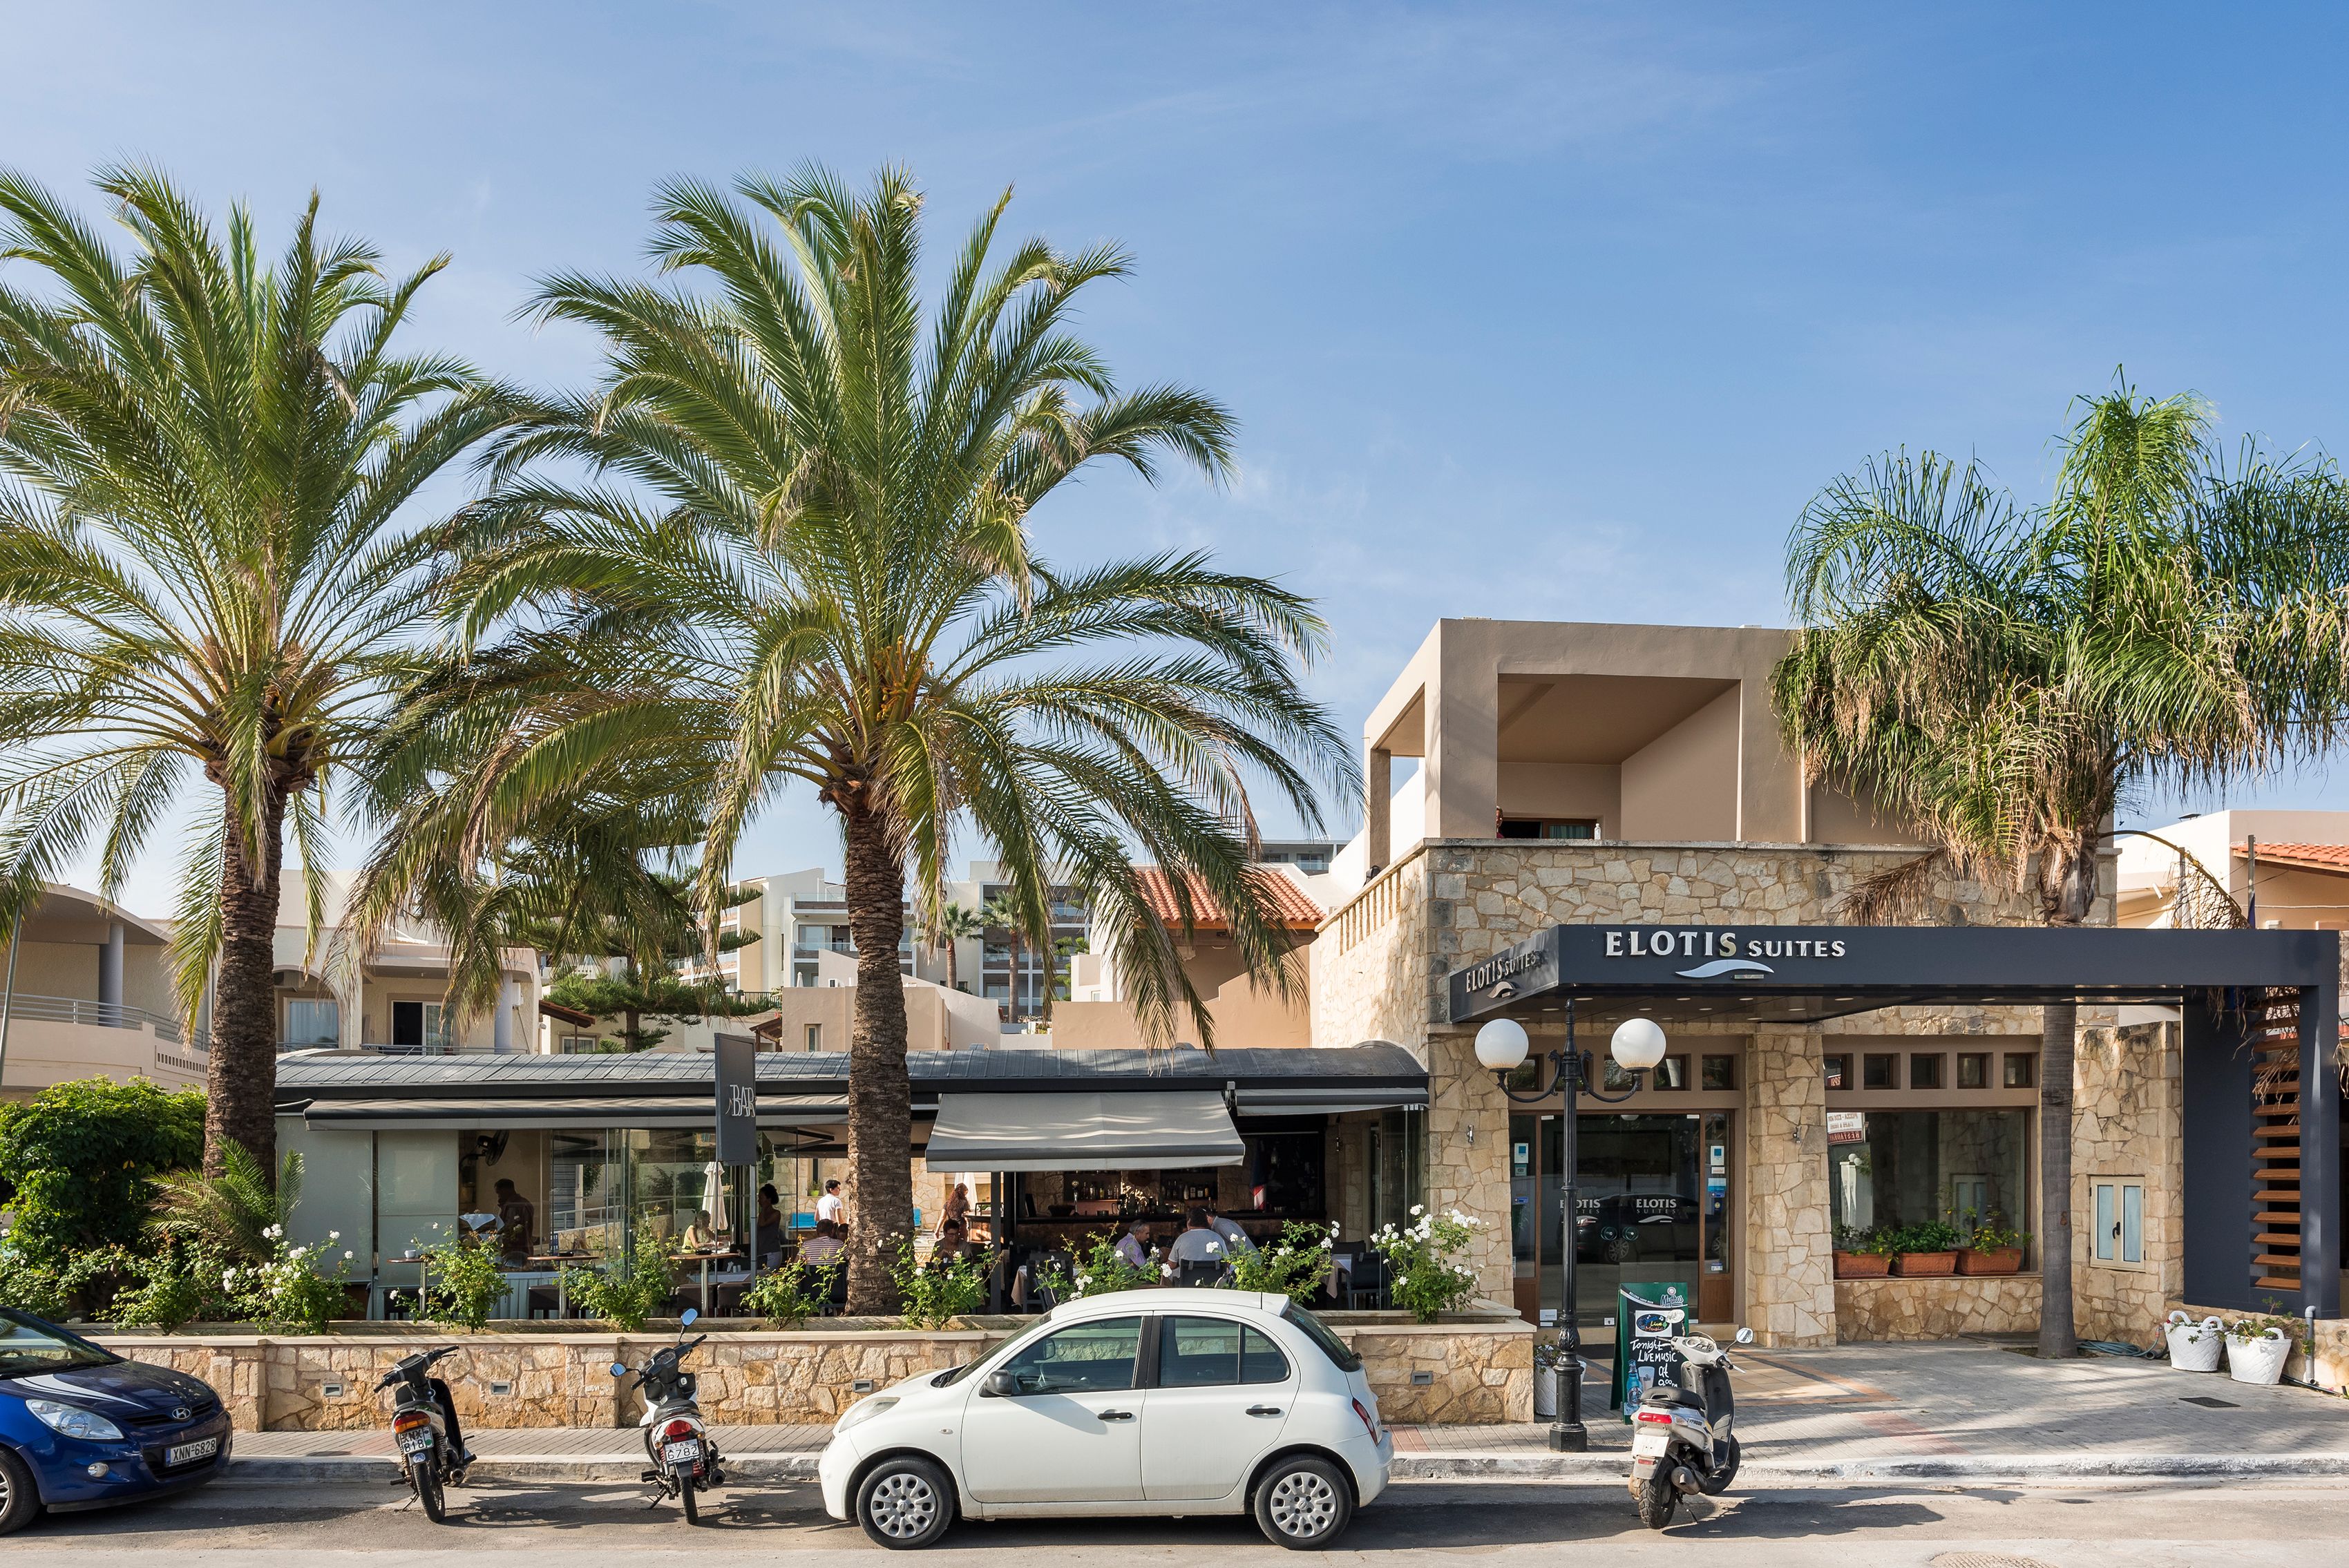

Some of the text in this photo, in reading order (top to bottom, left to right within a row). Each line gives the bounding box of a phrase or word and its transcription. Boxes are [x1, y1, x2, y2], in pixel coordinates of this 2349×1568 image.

[1605, 930, 1846, 957] ELOTIS SUITES
[1466, 951, 1537, 993] ELOTIS SUITES
[729, 1084, 755, 1118] BAR
[1559, 1198, 1601, 1208] EOTIS
[1636, 1198, 1677, 1208] ELOTIS
[1660, 1294, 1684, 1307] Mythos
[1630, 1339, 1664, 1353] Tonight
[1637, 1349, 1655, 1362] LIVE
[1659, 1363, 1669, 1378] at
[404, 1439, 425, 1453] 818
[667, 1446, 698, 1460] 6782
